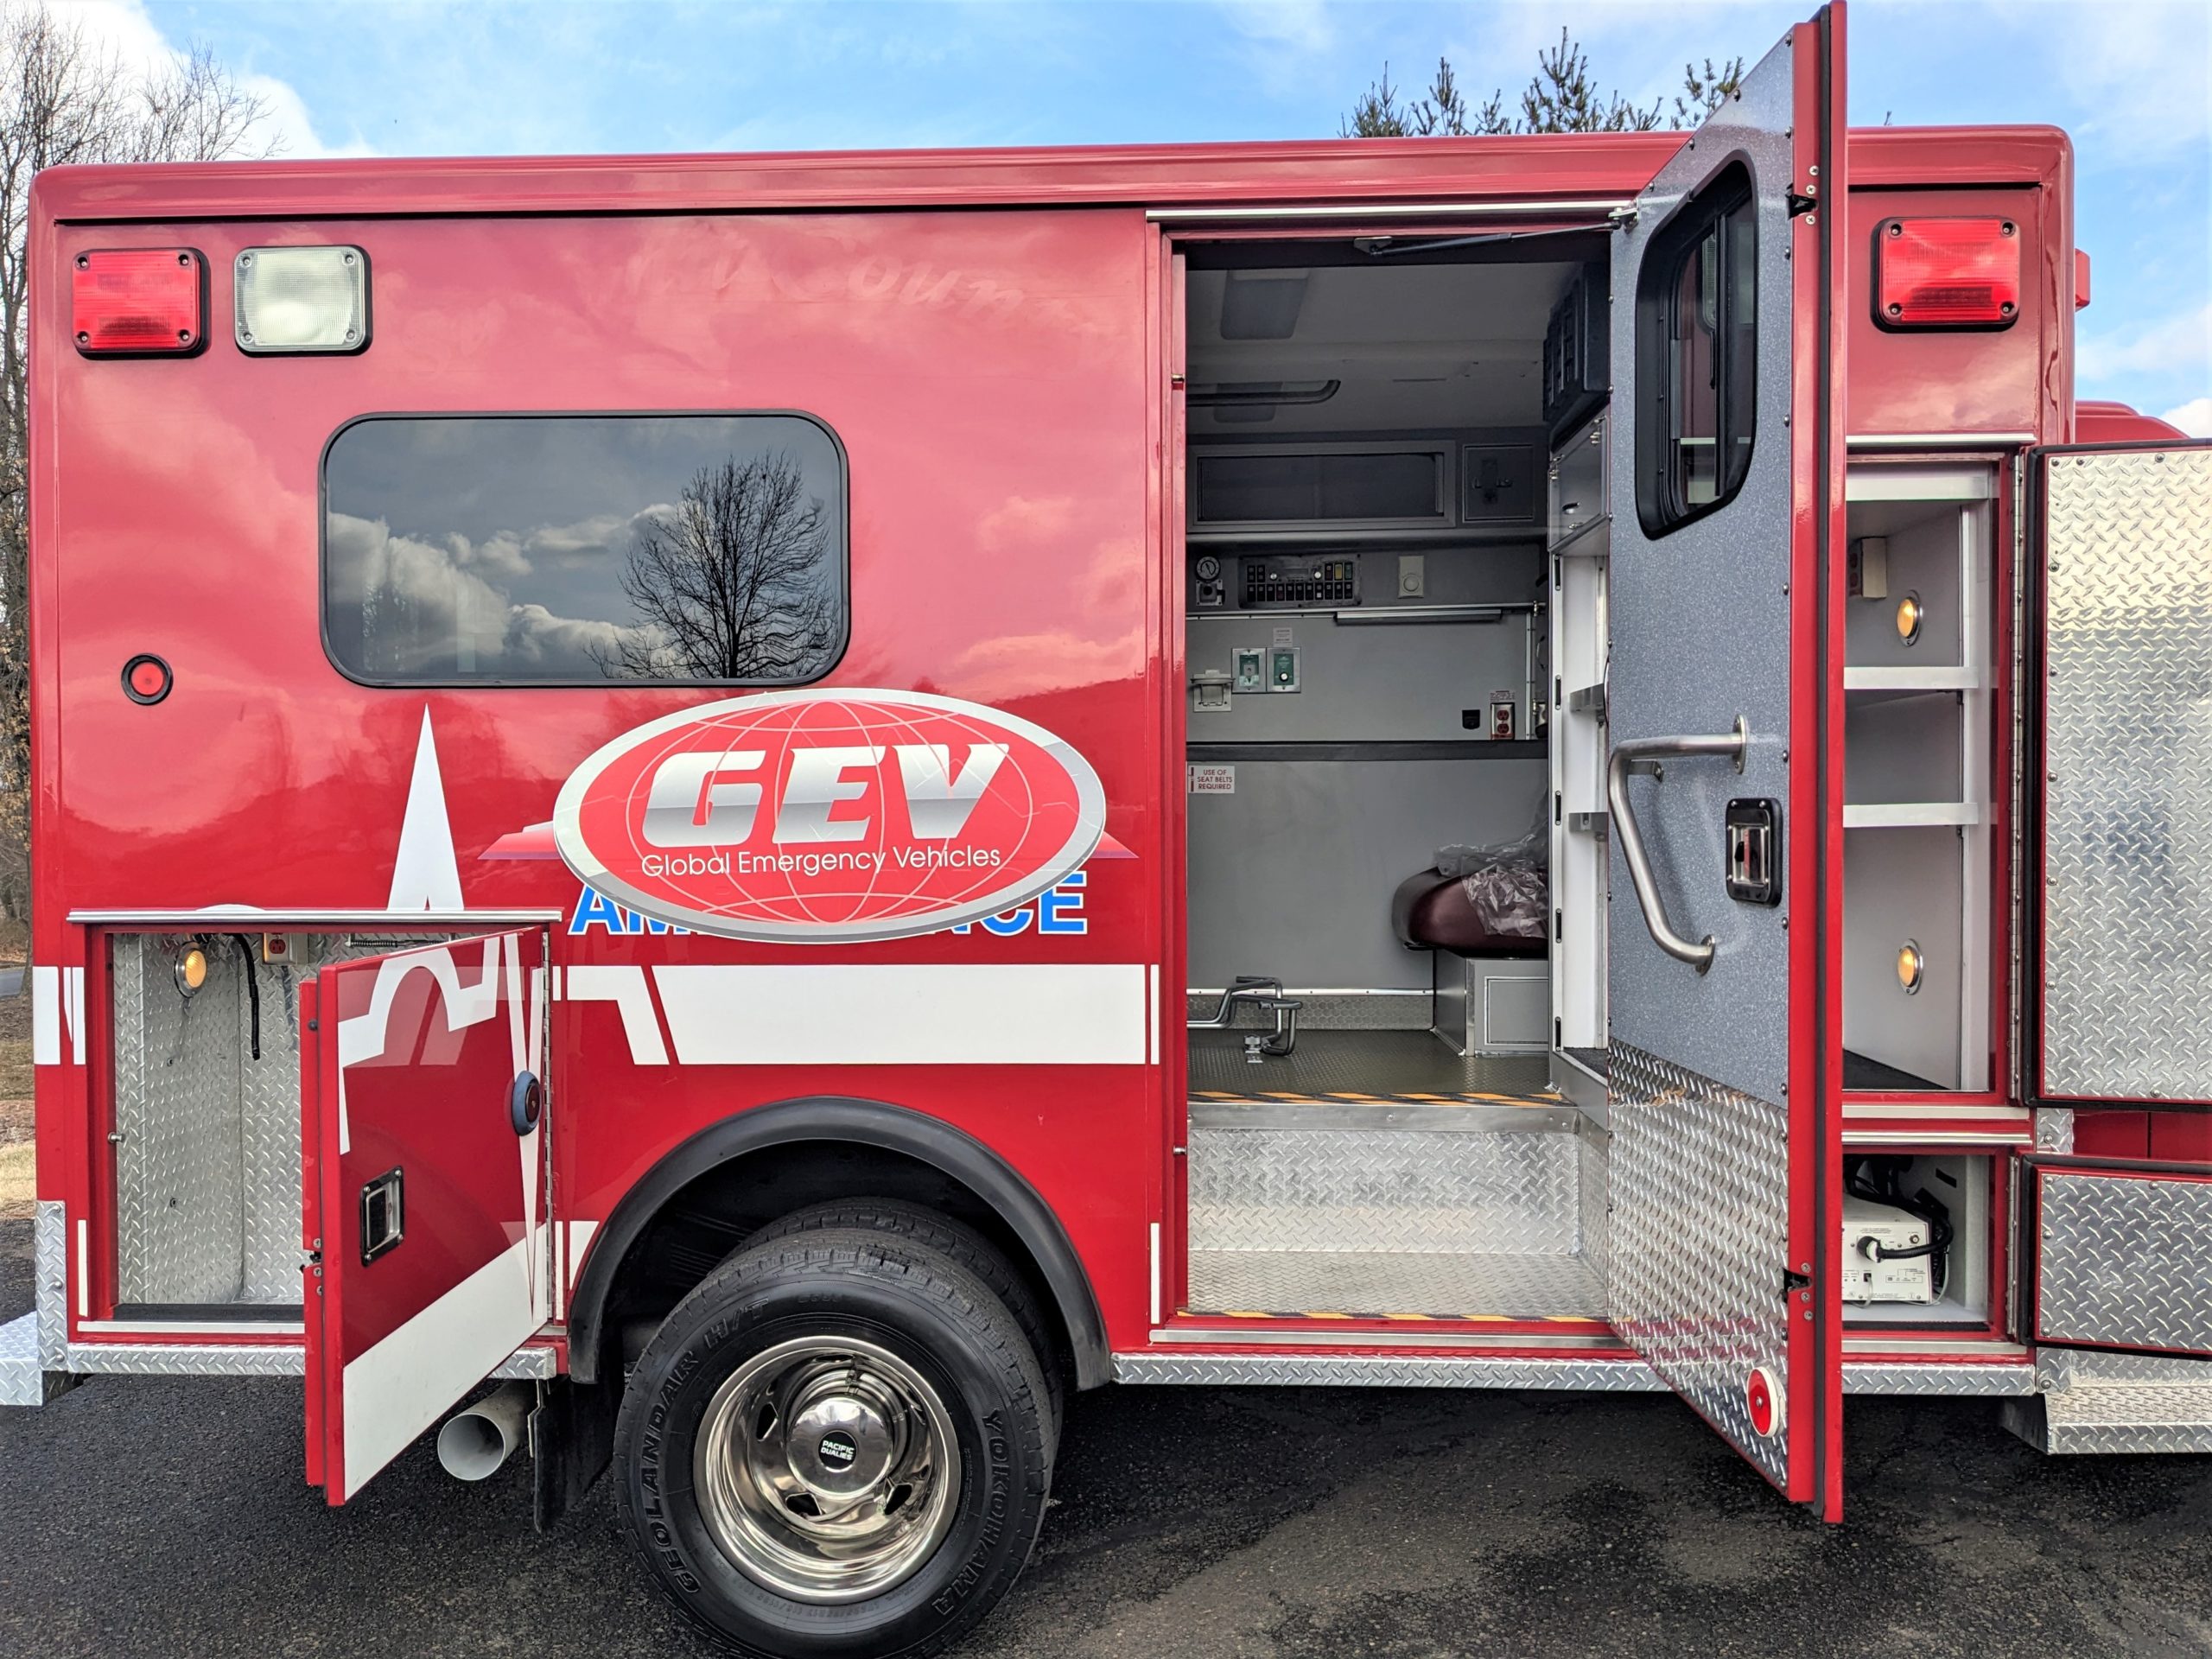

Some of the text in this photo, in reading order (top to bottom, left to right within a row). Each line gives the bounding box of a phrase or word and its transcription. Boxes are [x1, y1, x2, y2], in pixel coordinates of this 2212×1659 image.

[641, 743, 1010, 848] GEV
[641, 844, 1001, 877] Global Emergency Vehicles
[641, 1298, 769, 1593] GEOLANDAR H/T
[820, 1446, 854, 1460] DUALIES
[822, 1440, 855, 1455] PACIFIC
[931, 1408, 1010, 1616] YOKOHAMA
